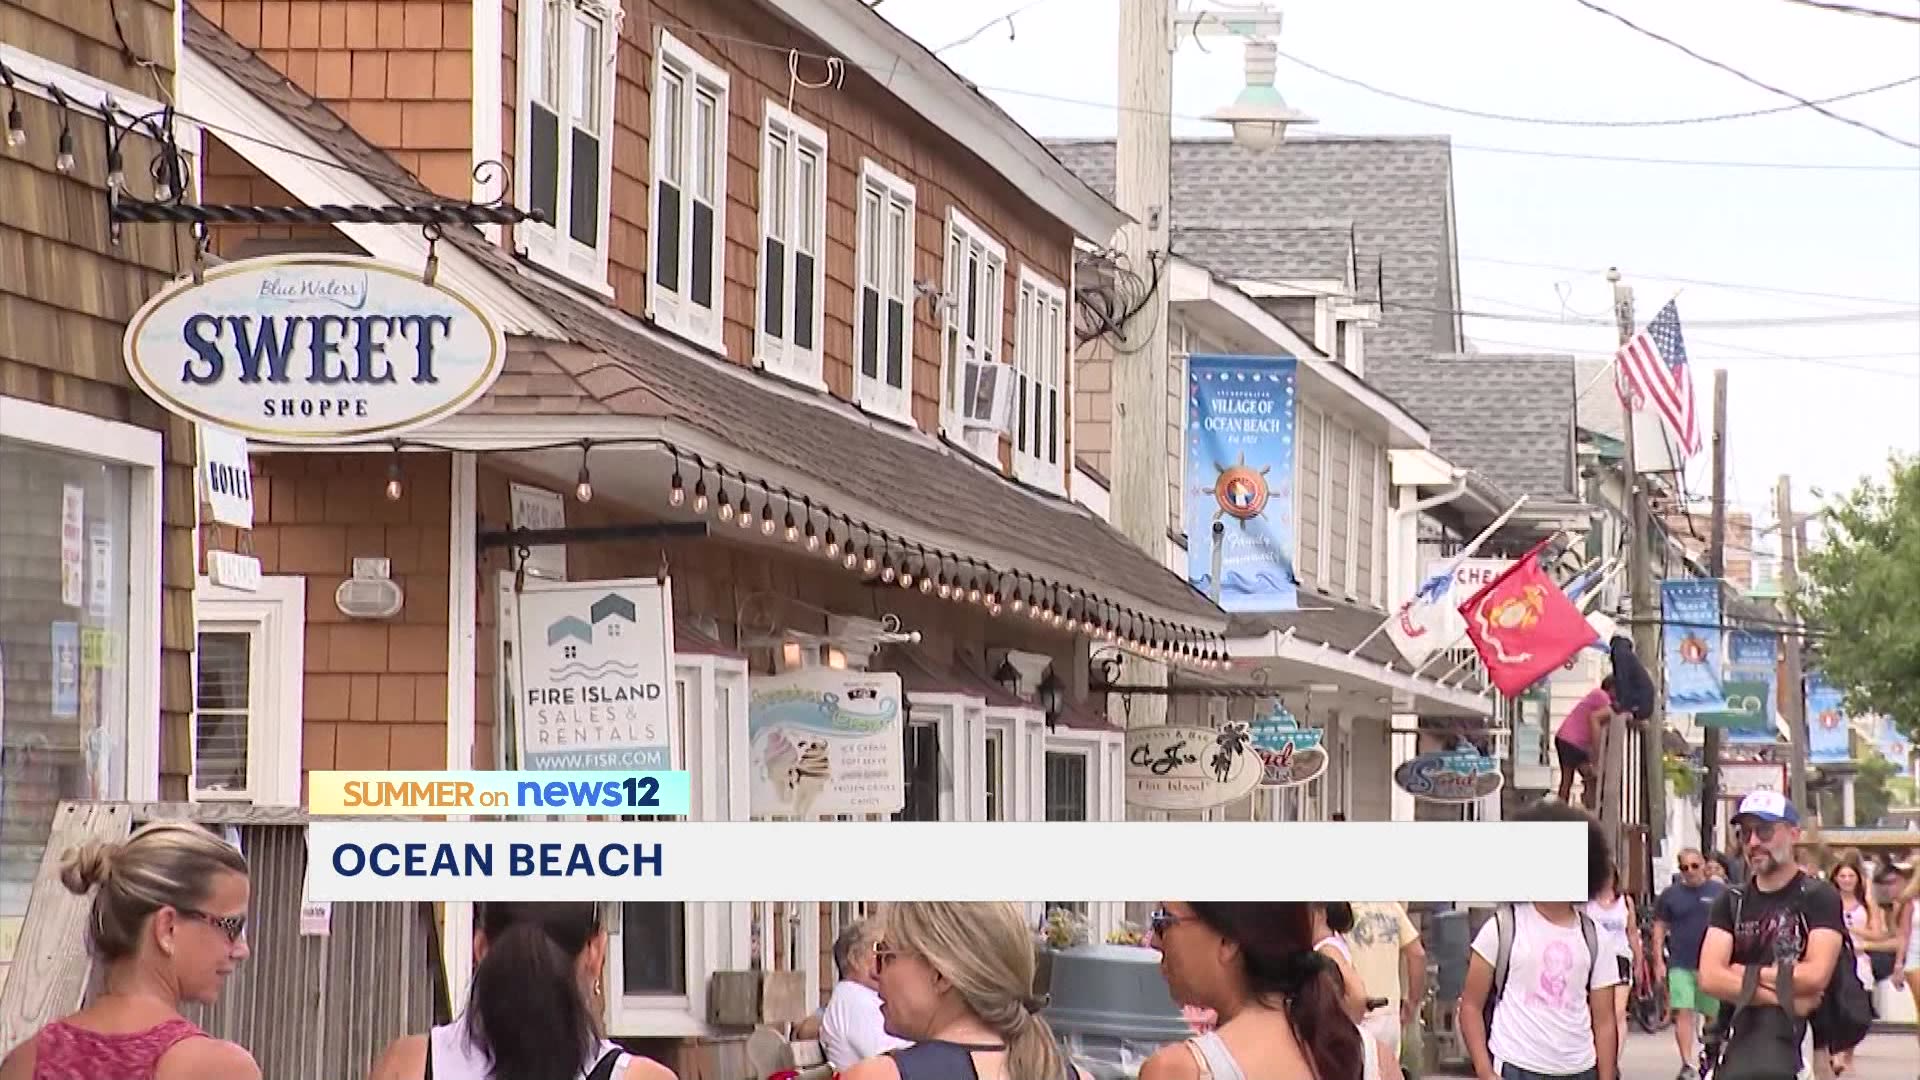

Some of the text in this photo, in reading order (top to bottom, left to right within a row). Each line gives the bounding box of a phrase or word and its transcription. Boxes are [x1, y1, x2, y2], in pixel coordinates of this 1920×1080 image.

[259, 278, 297, 296] Blue
[182, 313, 452, 384] SWEET
[263, 398, 368, 417] SHOPPE
[1211, 398, 1275, 415] VILLAGE OF
[1204, 416, 1280, 433] OCEAN BEACH
[1457, 567, 1500, 585] CHE
[528, 683, 661, 706] FIRE ISLAND
[538, 705, 638, 725] SALES &
[539, 723, 656, 745] RENTALS
[536, 751, 662, 769] WWW.FISR.COM
